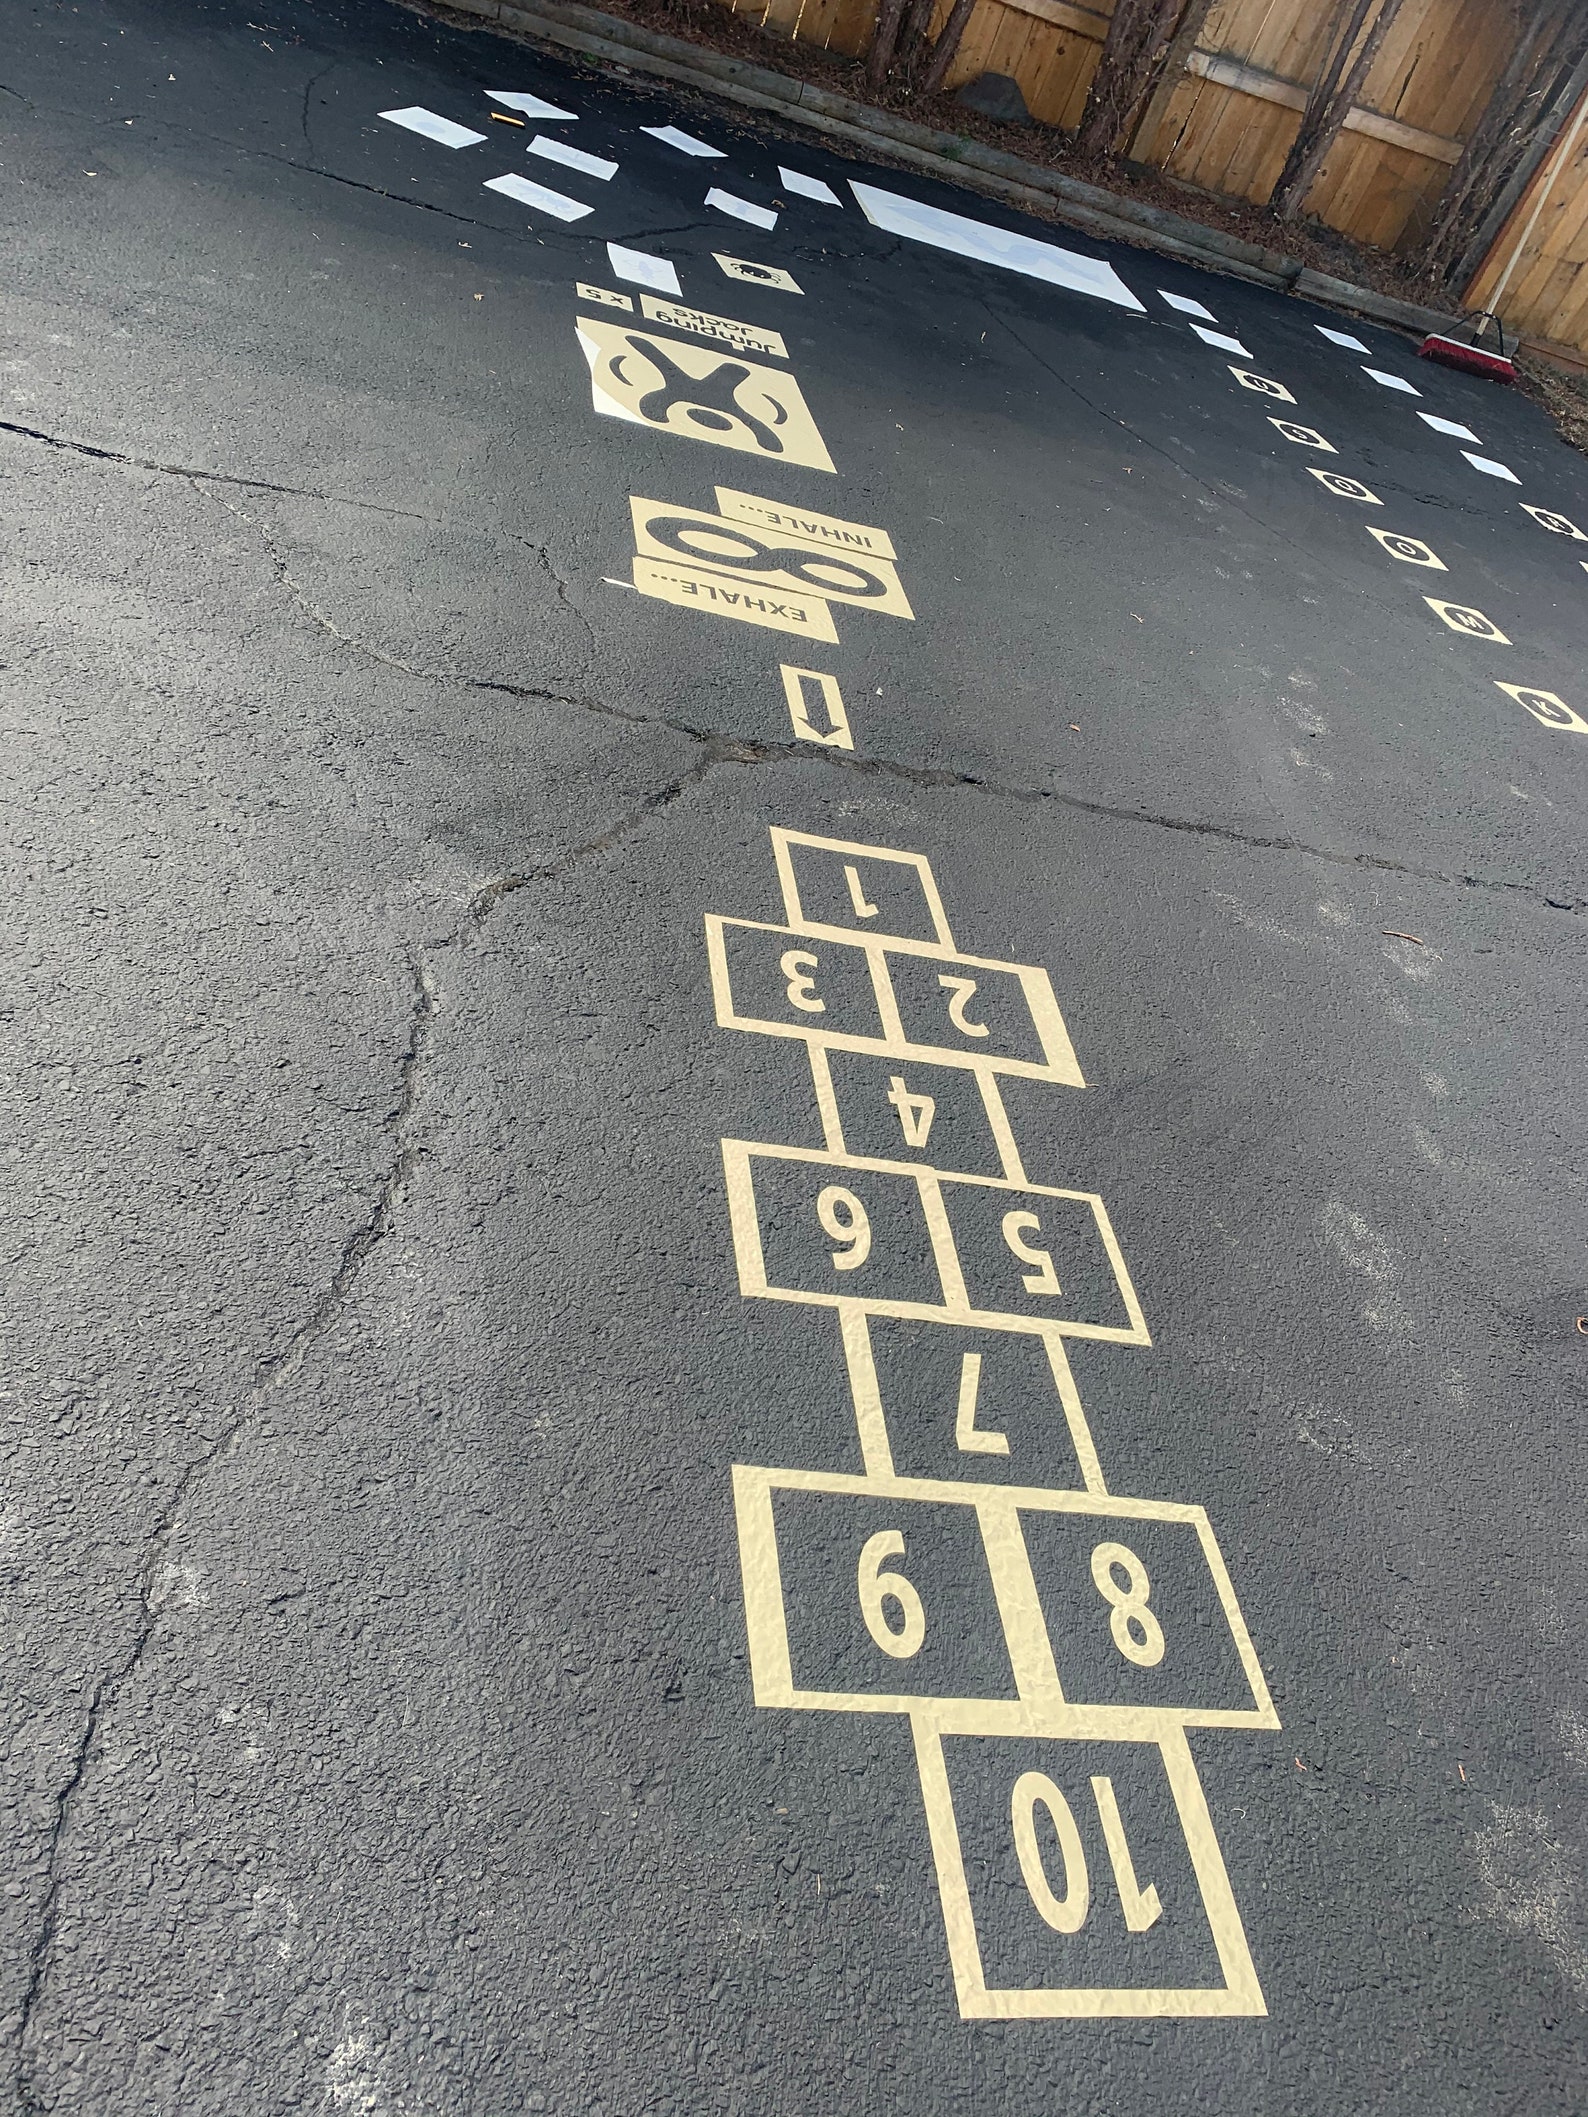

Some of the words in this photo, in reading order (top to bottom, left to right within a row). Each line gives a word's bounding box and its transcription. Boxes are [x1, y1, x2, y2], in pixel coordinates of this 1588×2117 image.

[655, 310, 776, 350] Jumping
[1292, 429, 1308, 440] S
[739, 503, 873, 549] INHALE...
[650, 573, 809, 623] EXHALE...
[1455, 612, 1485, 630] M
[1531, 699, 1561, 718] K
[843, 865, 880, 918] 1
[779, 949, 827, 1013] 3
[937, 973, 990, 1038] 2
[887, 1075, 936, 1149] 4
[1001, 1210, 1063, 1296] 5
[955, 1352, 1011, 1455] 7
[1090, 1541, 1166, 1667] 8
[1011, 1771, 1164, 1934] 10
